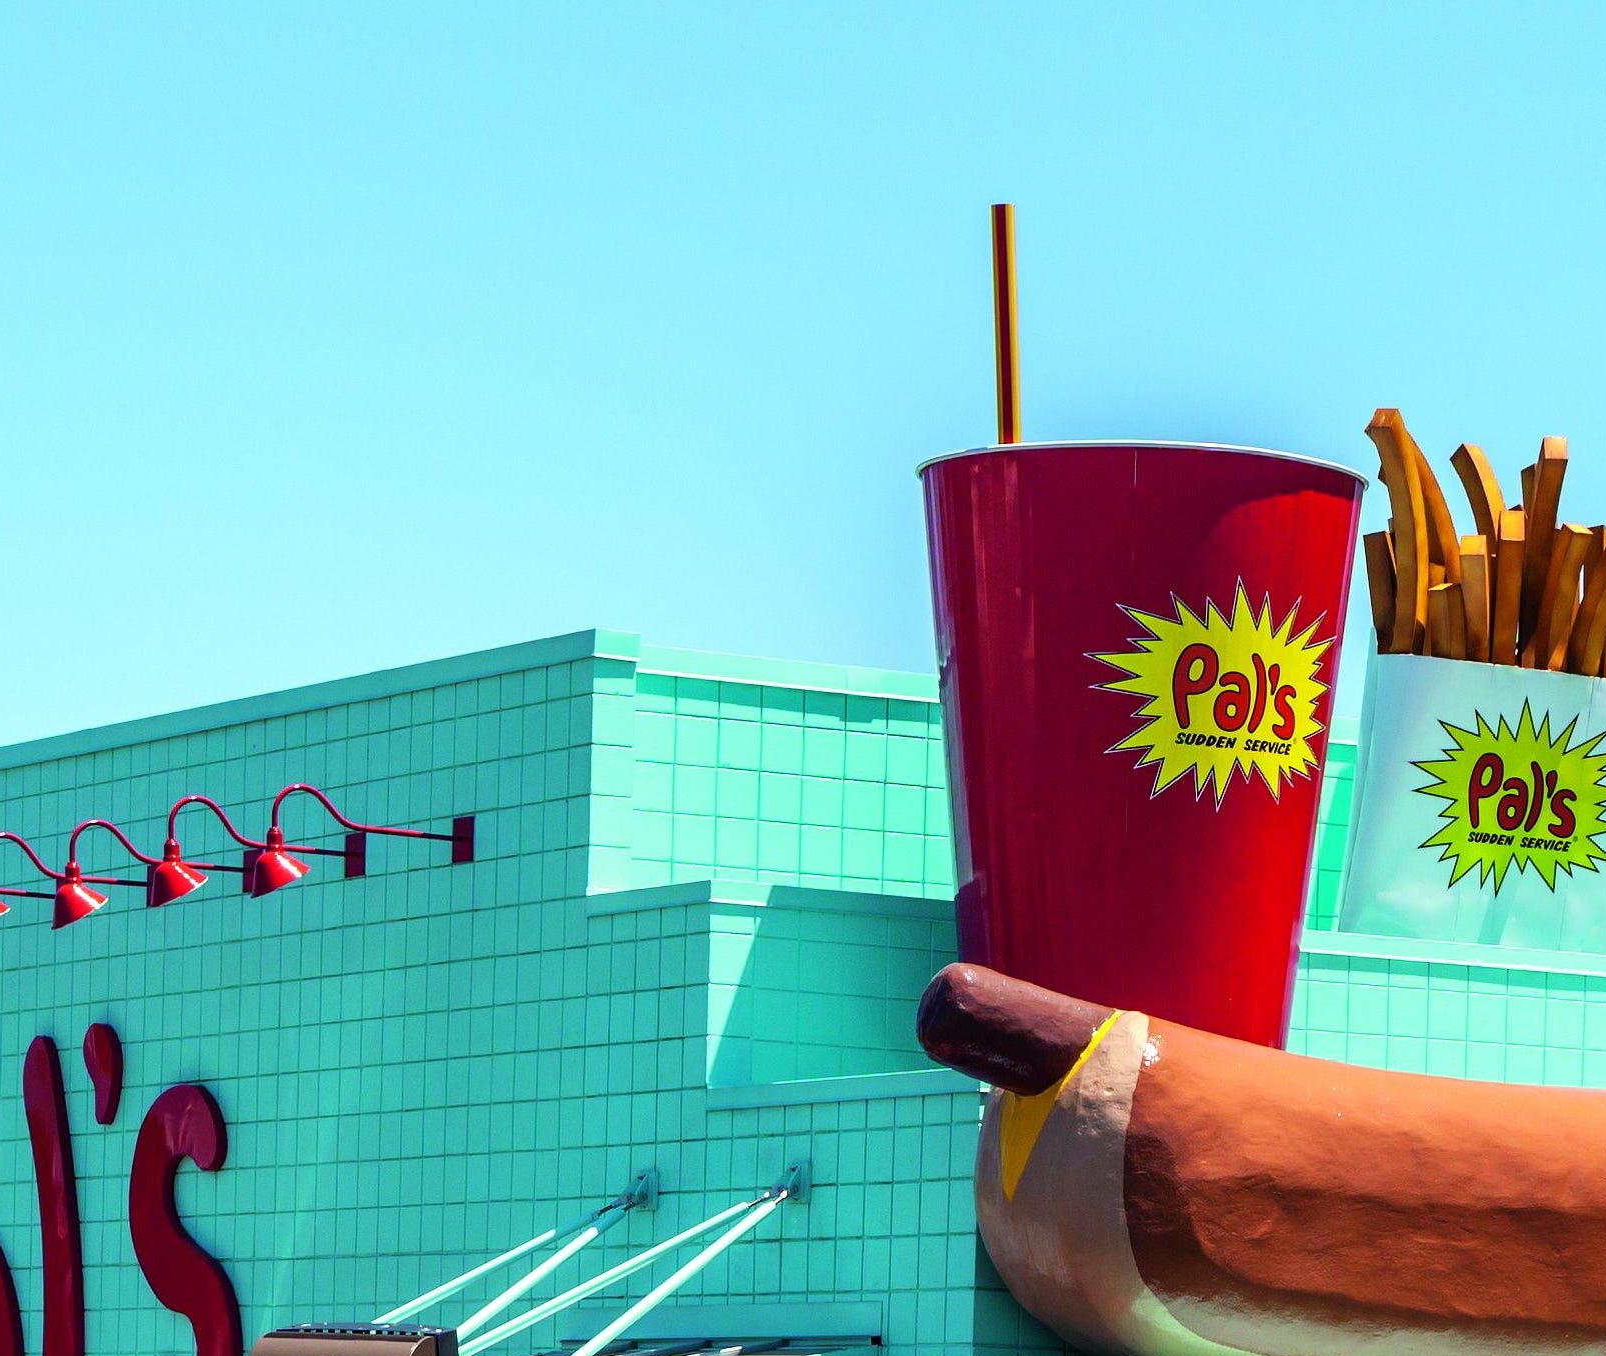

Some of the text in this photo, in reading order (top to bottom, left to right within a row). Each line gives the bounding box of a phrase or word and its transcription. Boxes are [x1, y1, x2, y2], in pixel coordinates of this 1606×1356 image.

[1172, 642, 1297, 741] Pal's
[1174, 731, 1292, 756] SUDDEN SERVICE
[1468, 752, 1578, 839] Pal's
[1467, 831, 1572, 853] SUDDEN SERVICE
